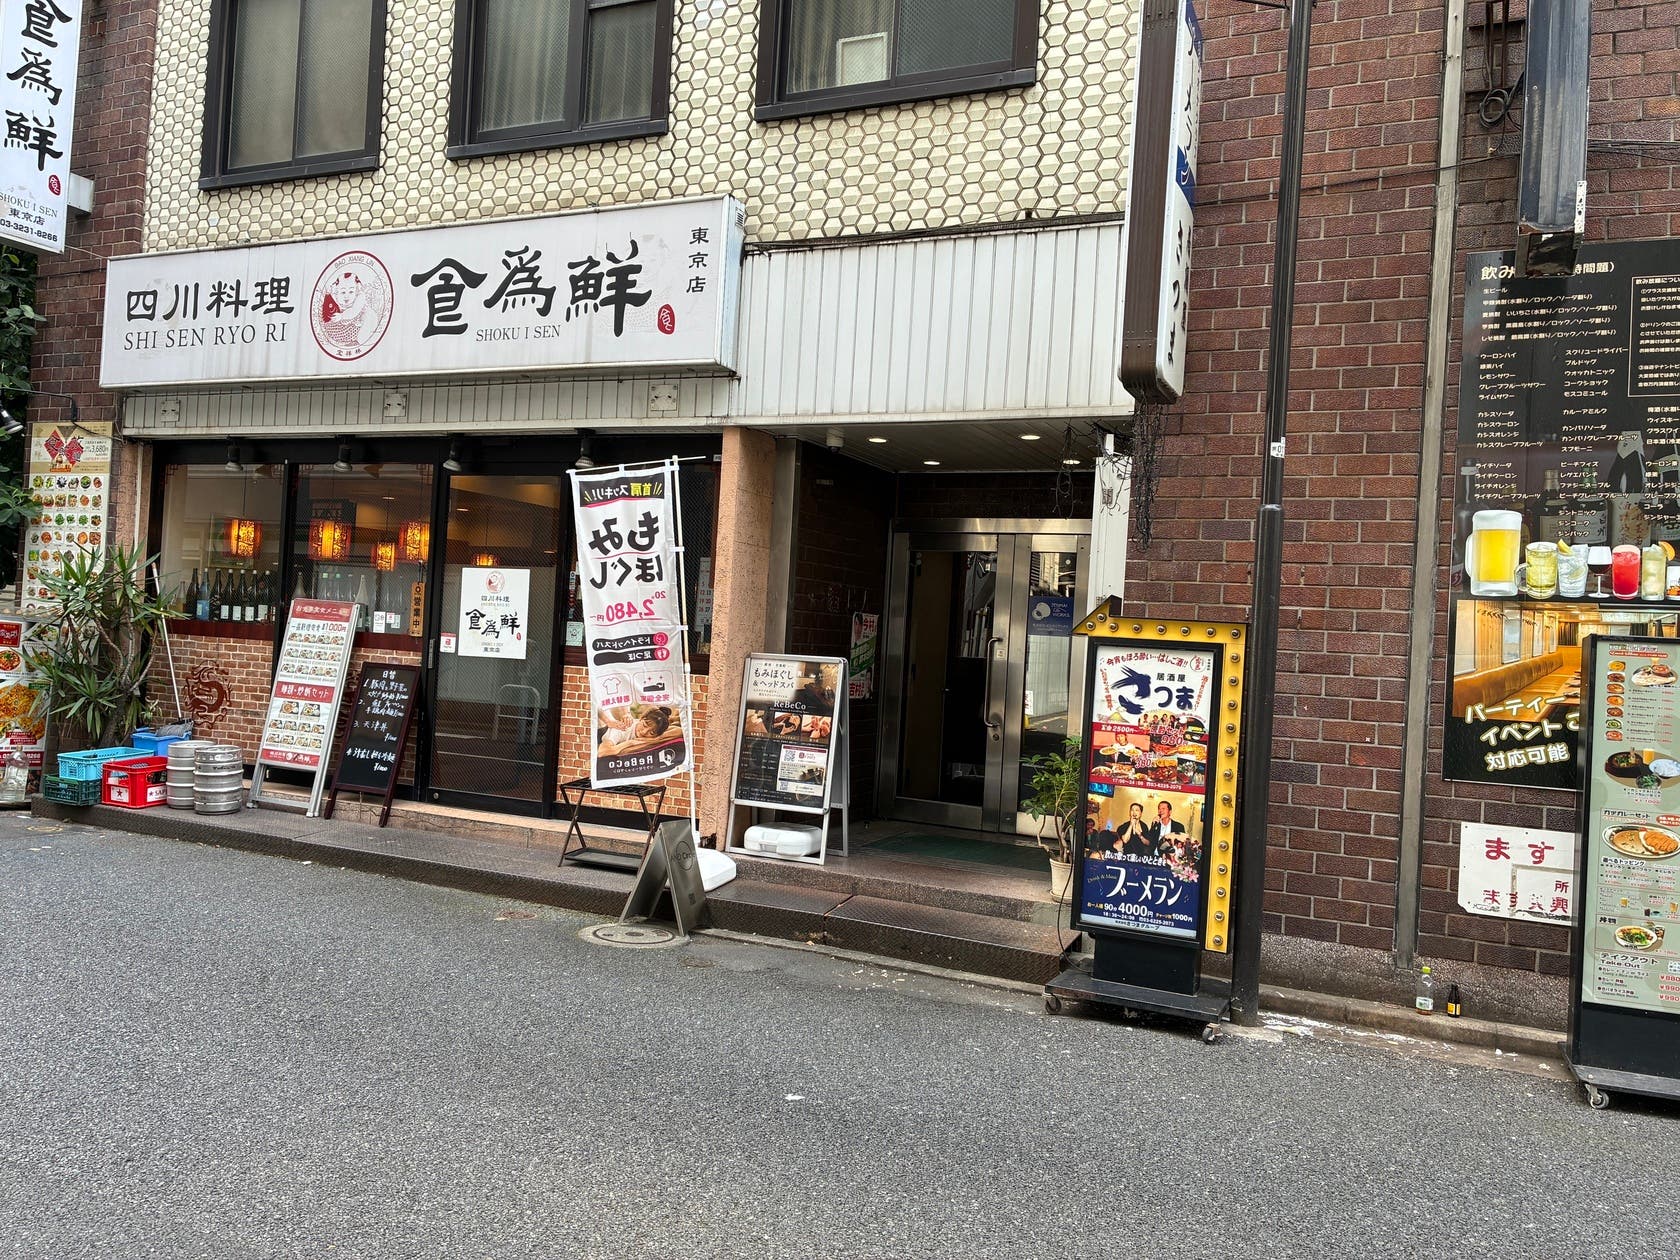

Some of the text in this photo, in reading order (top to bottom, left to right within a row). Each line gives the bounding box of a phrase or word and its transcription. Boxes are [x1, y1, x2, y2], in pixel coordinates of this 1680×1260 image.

[9, 207, 45, 226] 東京店
[39, 205, 58, 218] SEN
[686, 227, 709, 293] 東京店
[1483, 287, 1507, 295] 生ビール
[126, 276, 295, 322] 四川料理
[124, 322, 287, 350] SHI SEN RYO RI
[476, 325, 561, 342] SHOKU I SEN
[1480, 352, 1517, 360] ウーロンハイ
[1565, 347, 1629, 355] スクリュードライバー
[1564, 390, 1608, 398] モスコミュール
[1477, 410, 1515, 418] カシスソーダ
[1562, 408, 1608, 416] カルーアミルク
[1562, 434, 1638, 442] カンパリグレープフルーツ
[481, 595, 510, 603] 四川料理
[413, 596, 422, 628] 営業中
[754, 667, 794, 680] もみほぐし
[1157, 672, 1186, 682] 居酒屋
[773, 700, 806, 710] ReBeCo
[1464, 695, 1566, 724] パーティー
[1484, 743, 1570, 772] 対応可能
[1105, 865, 1183, 906] ブーメラン
[1118, 902, 1154, 917] 4000円
[1172, 913, 1193, 922] 1000円
[1601, 953, 1658, 965] テイクアウト
